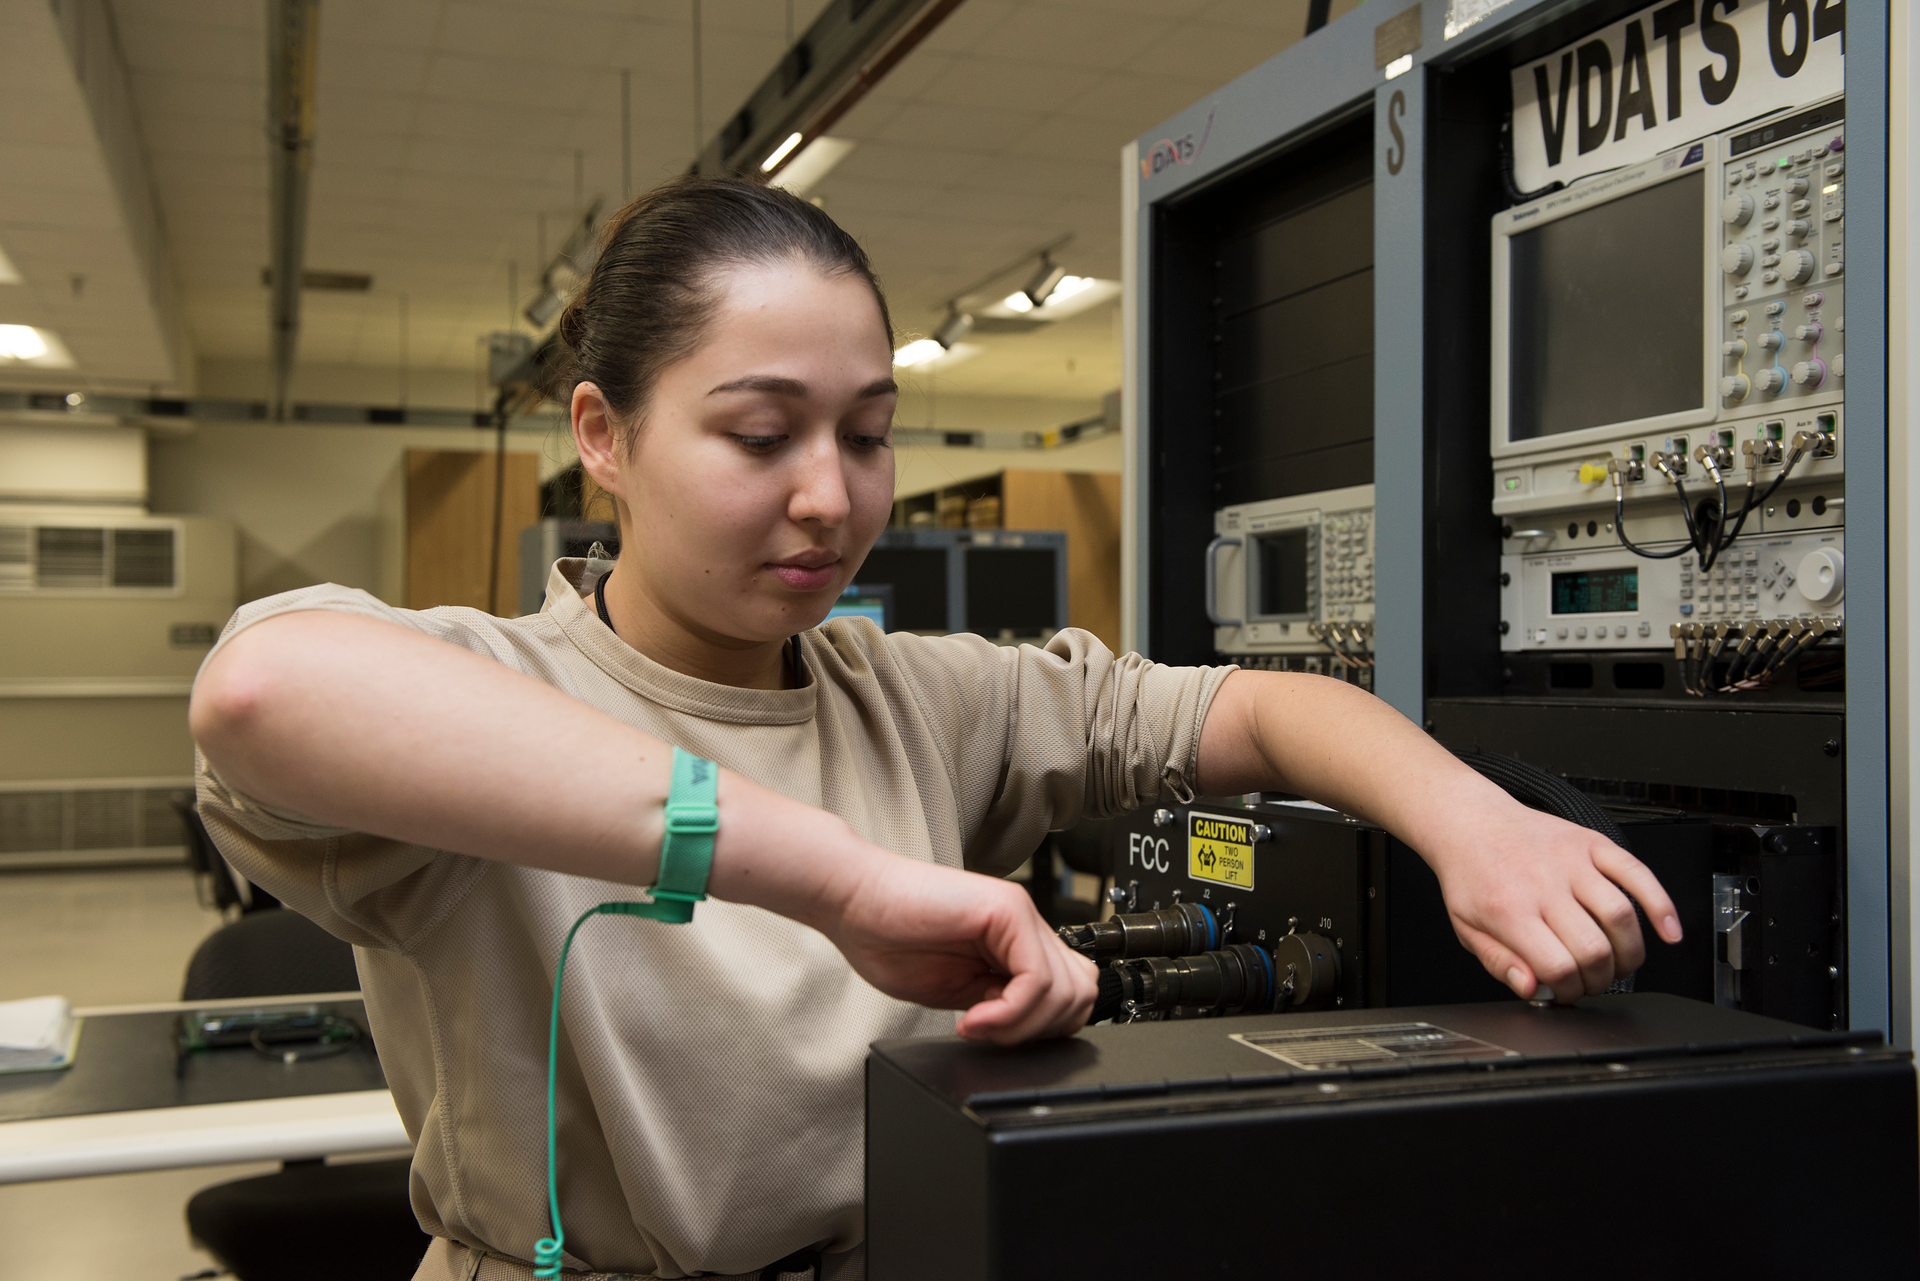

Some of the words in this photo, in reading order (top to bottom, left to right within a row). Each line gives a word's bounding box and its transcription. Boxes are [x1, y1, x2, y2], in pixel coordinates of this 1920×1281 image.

[1533, 0, 1741, 167] VDATS
[1195, 819, 1246, 843] CAUTION
[1129, 832, 1170, 874] FCC
[1224, 845, 1238, 857] TWO
[1219, 857, 1244, 870] PERSON
[1225, 870, 1238, 881] LIFT
[1203, 888, 1211, 899] J2
[1319, 916, 1332, 930] J10
[1257, 929, 1266, 941] J9
